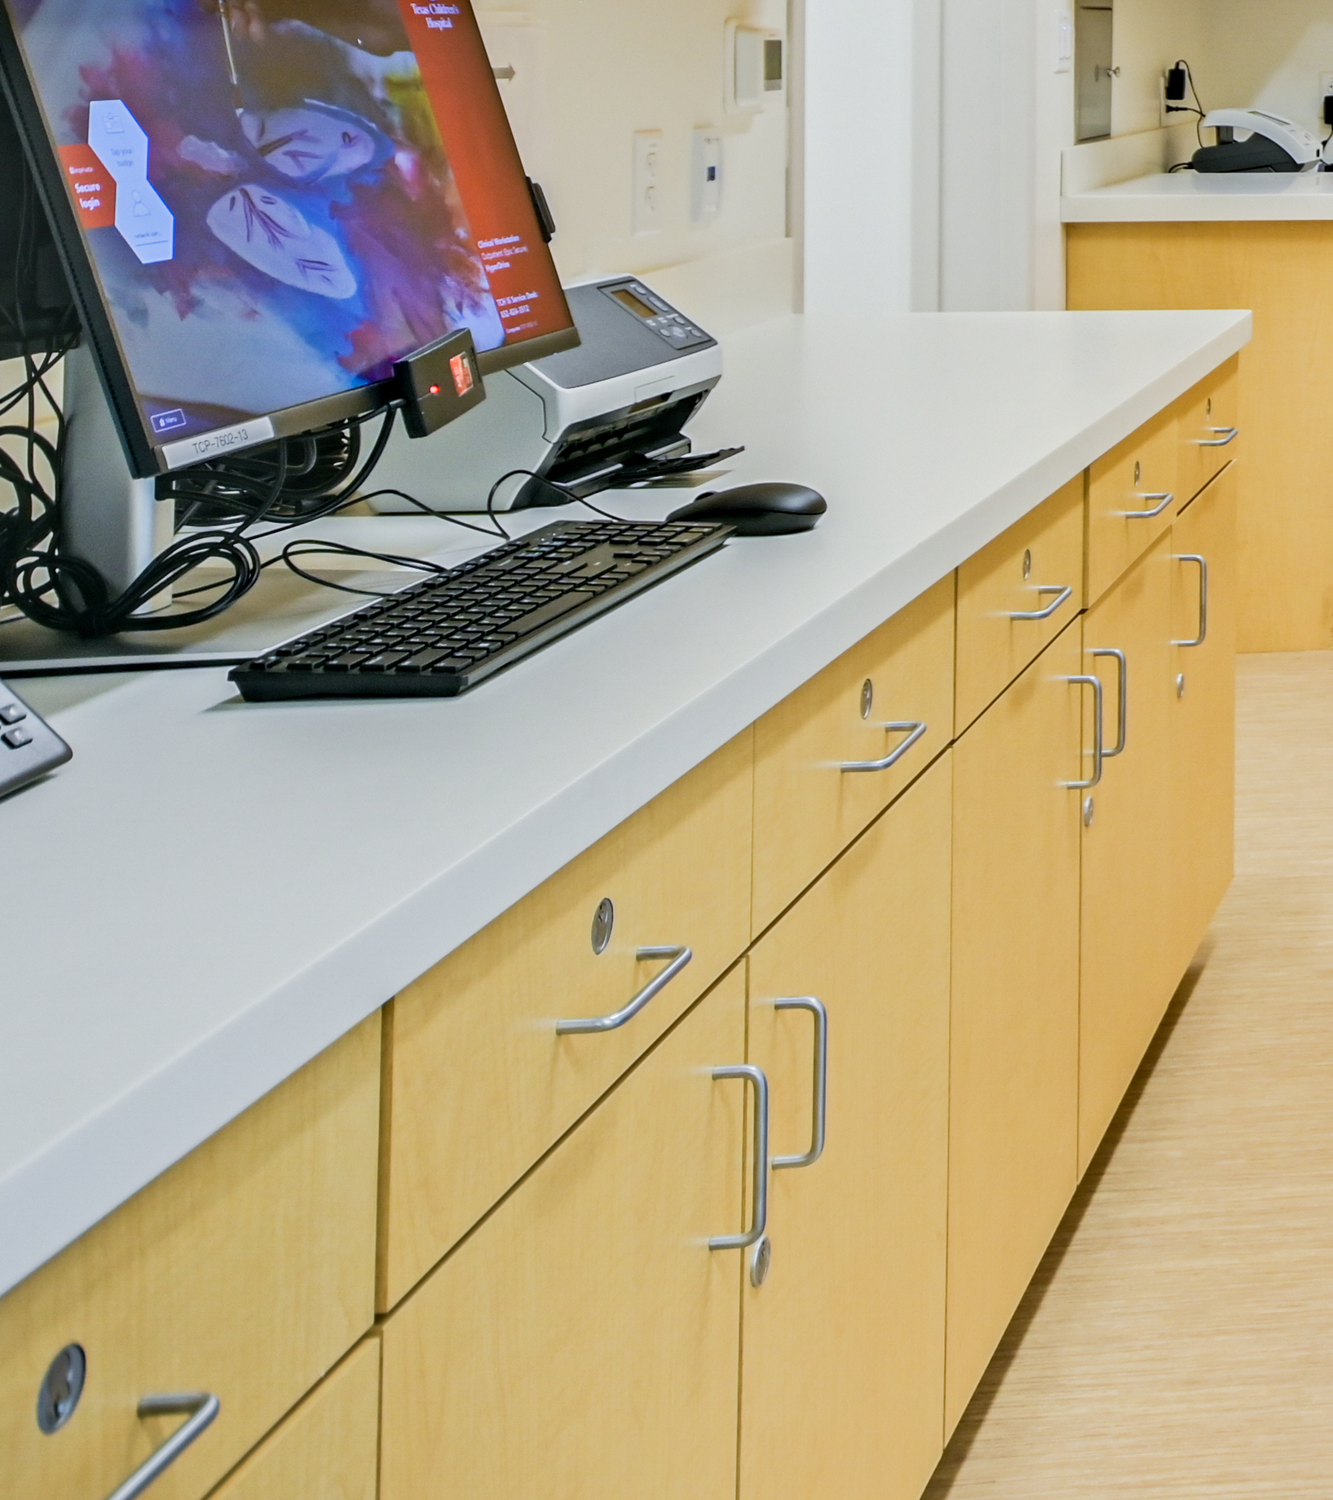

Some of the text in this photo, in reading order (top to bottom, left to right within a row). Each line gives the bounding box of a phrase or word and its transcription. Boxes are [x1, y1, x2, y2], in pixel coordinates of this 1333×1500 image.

[410, 3, 430, 14] Texas
[425, 17, 453, 31] Hospital
[75, 183, 101, 193] Secure
[79, 197, 101, 211] login
[192, 429, 249, 454] TCP-7602-13
